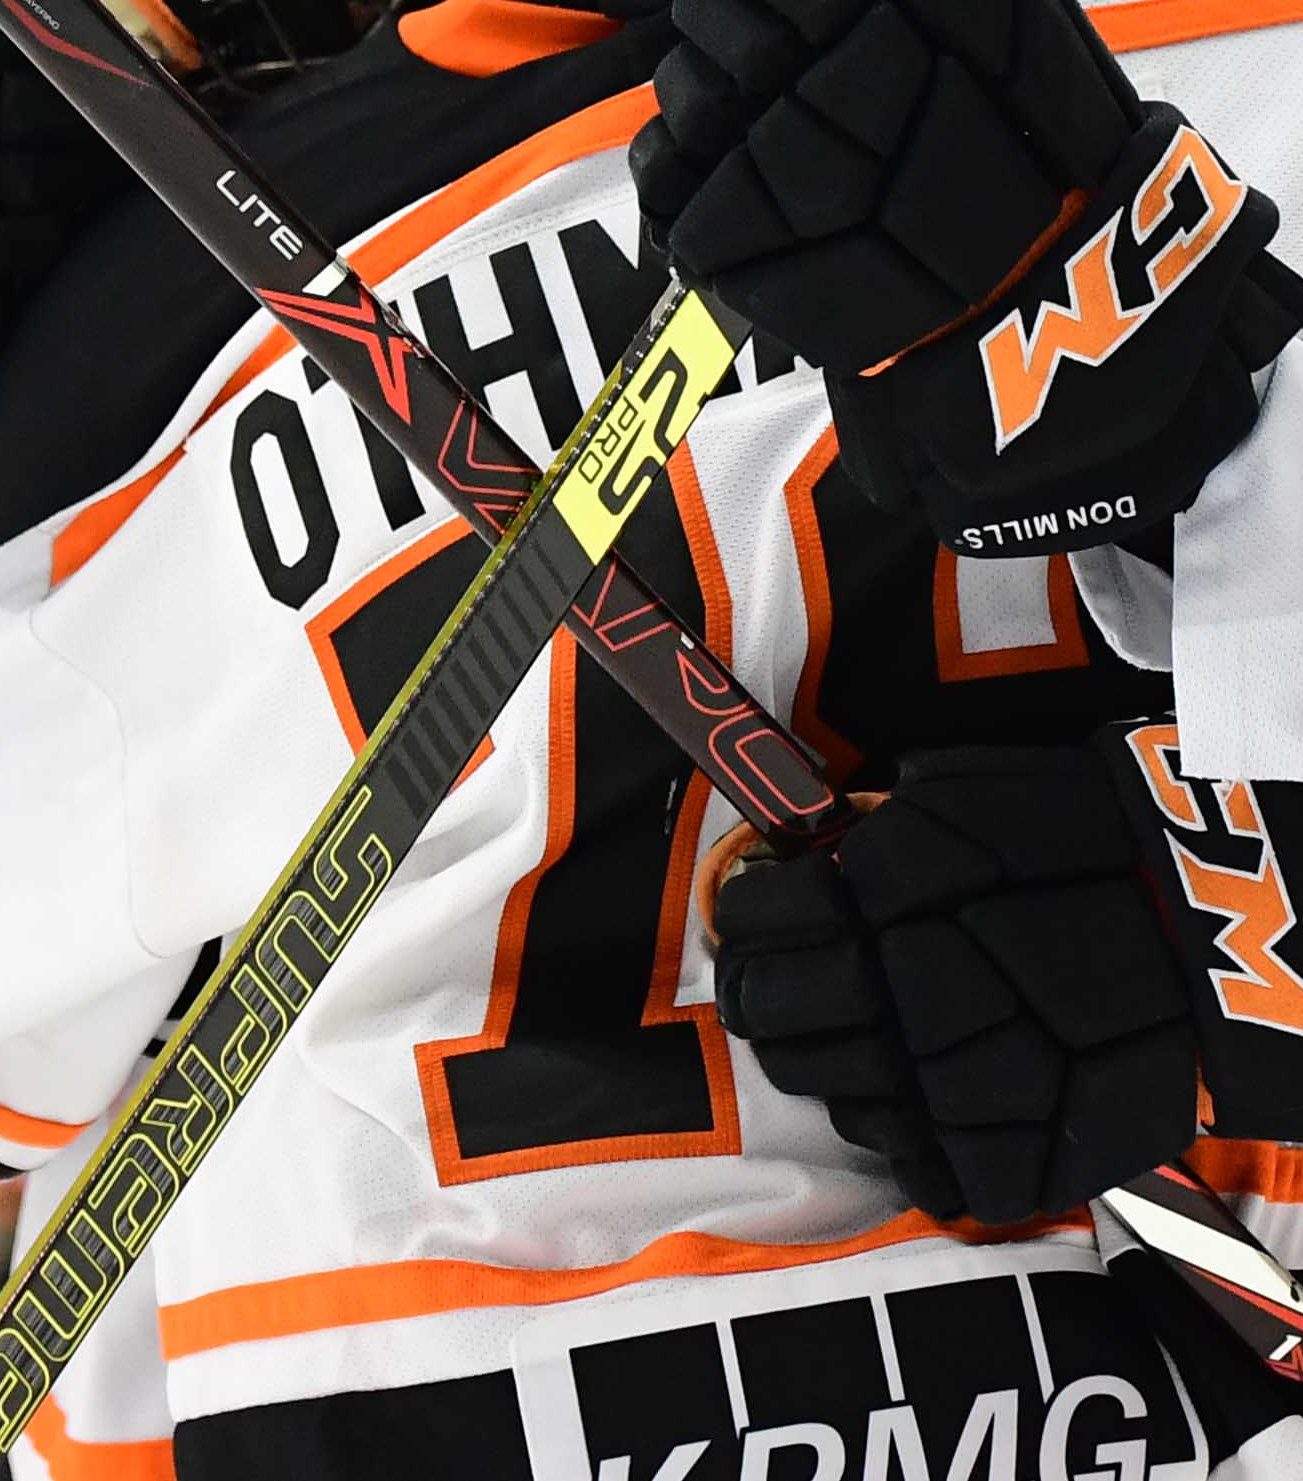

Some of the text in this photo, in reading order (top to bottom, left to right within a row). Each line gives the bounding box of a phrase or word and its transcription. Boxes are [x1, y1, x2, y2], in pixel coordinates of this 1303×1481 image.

[214, 168, 303, 261] LITE
[576, 392, 651, 486] PRO
[961, 496, 1138, 550] DON MILLS
